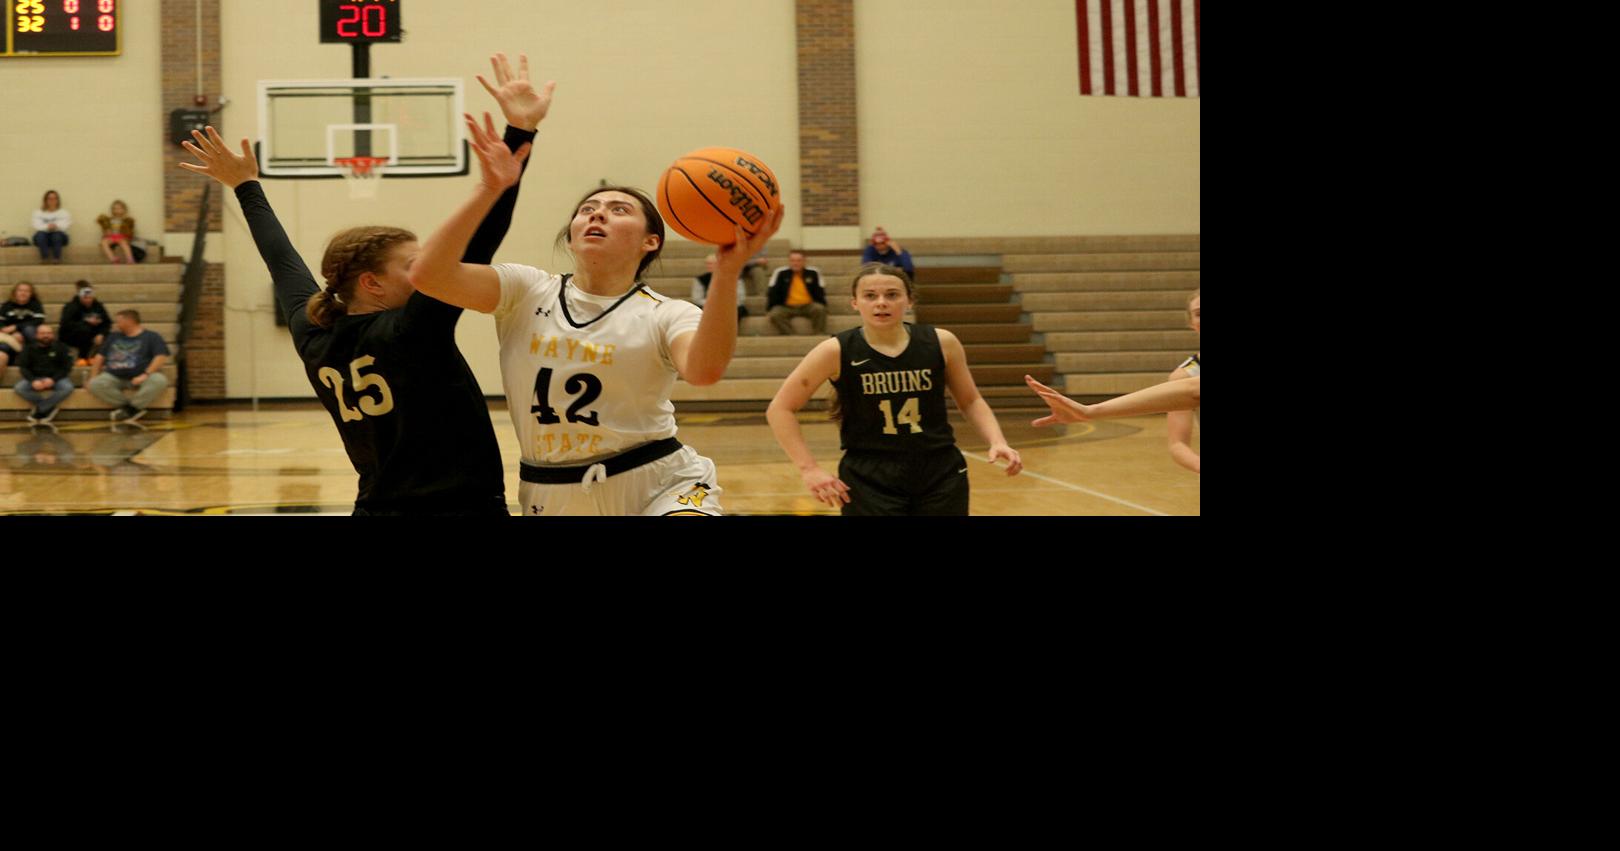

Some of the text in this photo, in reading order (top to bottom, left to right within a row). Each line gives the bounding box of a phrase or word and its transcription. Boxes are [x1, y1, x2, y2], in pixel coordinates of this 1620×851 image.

[16, 0, 114, 14] 25 0 0
[17, 14, 114, 32] 32 1 0
[336, 5, 386, 37] 20
[706, 169, 765, 225] Wilson
[529, 332, 616, 366] WAYNE
[318, 354, 394, 423] 25
[530, 367, 602, 426] 42
[860, 369, 932, 395] BRUINS
[878, 398, 923, 435] 14
